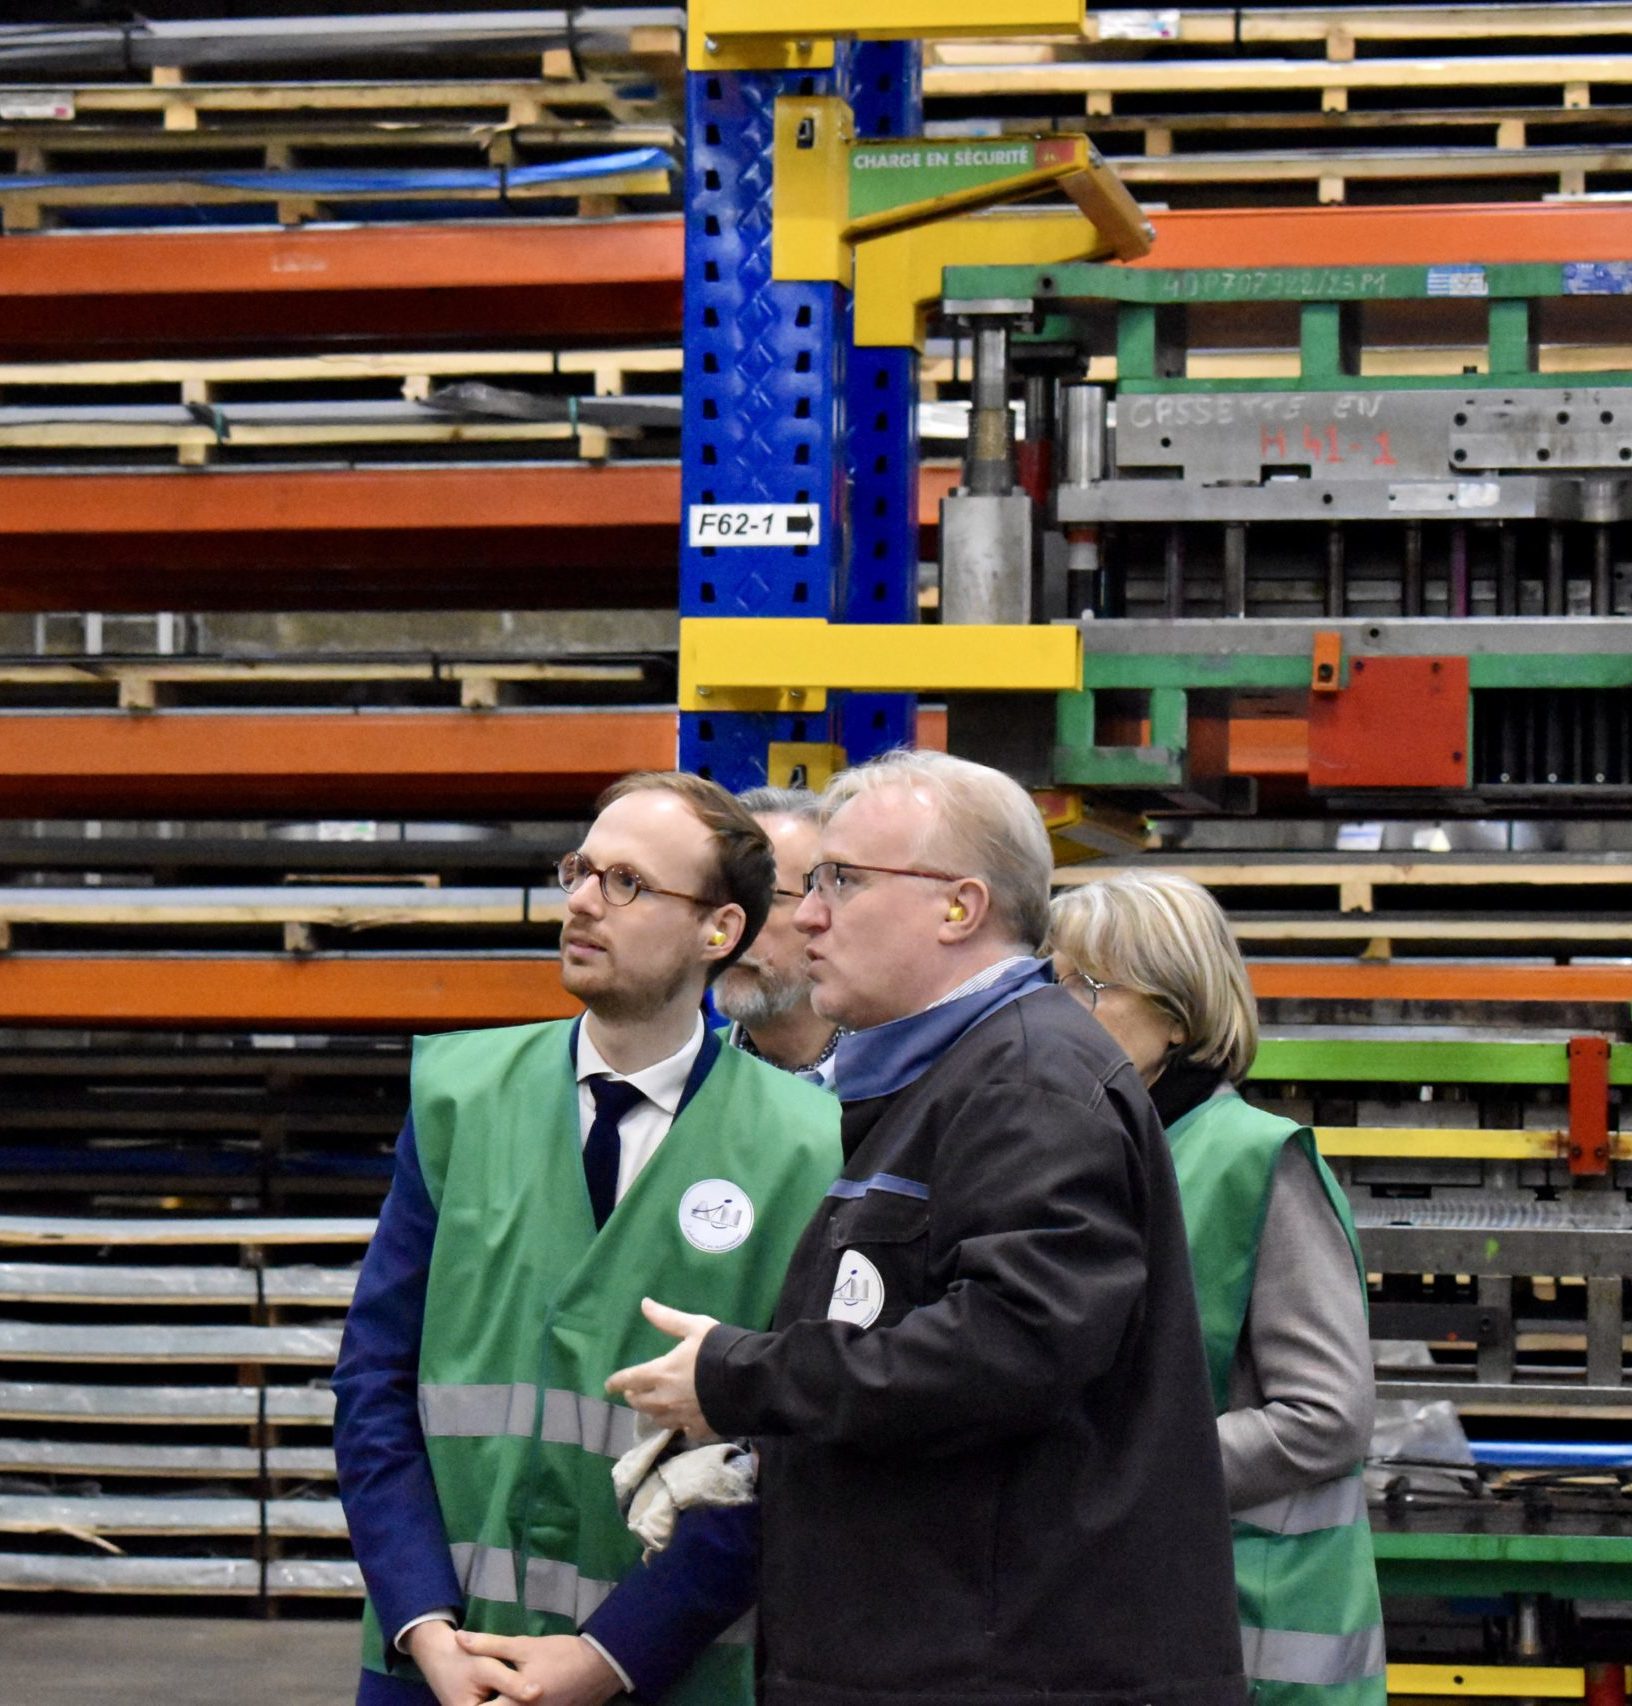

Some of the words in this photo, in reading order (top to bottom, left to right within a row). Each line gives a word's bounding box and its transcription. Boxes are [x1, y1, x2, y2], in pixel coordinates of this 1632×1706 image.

[854, 152, 922, 169] CHARGE
[926, 150, 949, 167] EN
[1130, 395, 1306, 428] CASSETTE
[698, 512, 774, 536] F62-1
